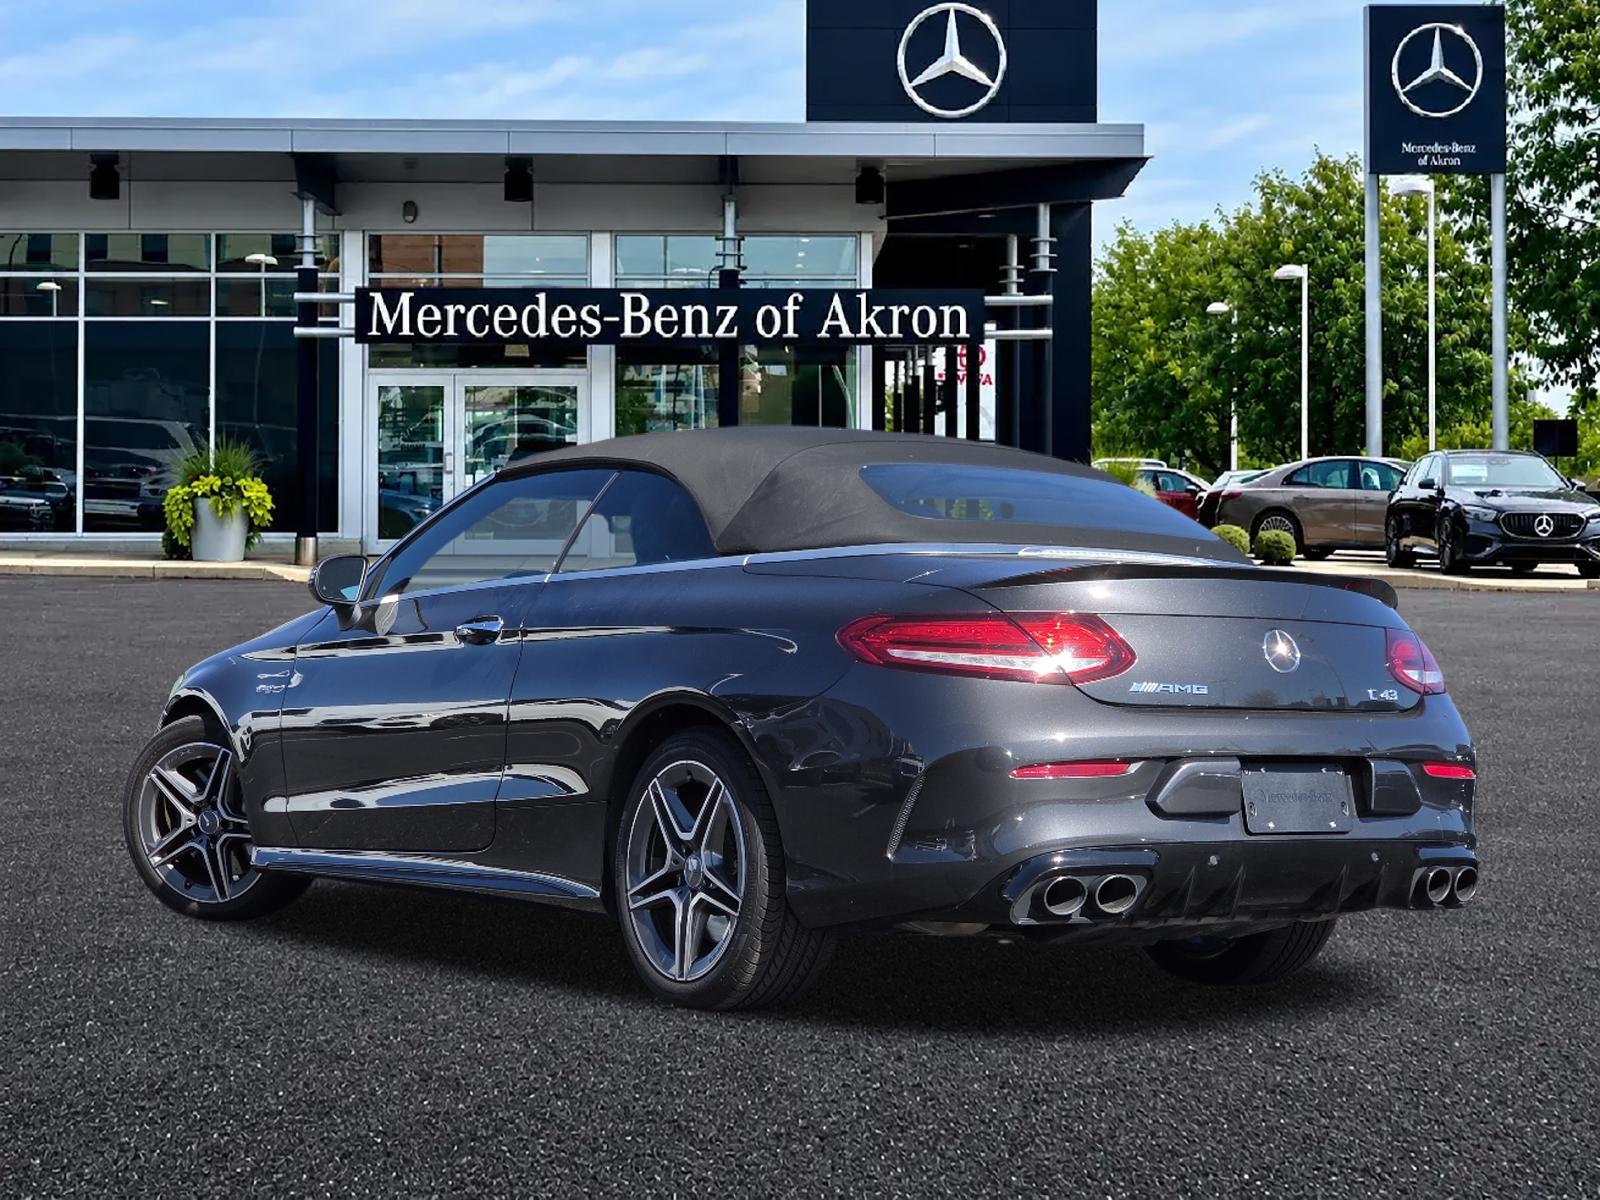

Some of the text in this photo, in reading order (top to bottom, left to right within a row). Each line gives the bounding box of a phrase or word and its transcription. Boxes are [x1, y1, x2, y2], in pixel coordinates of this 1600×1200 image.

[1401, 142, 1477, 154] Mercedes-Benz
[1417, 155, 1461, 166] of Akron
[367, 291, 971, 338] Mercedes-Benz of Akron
[1154, 683, 1209, 695] AMG
[1379, 689, 1398, 700] 43
